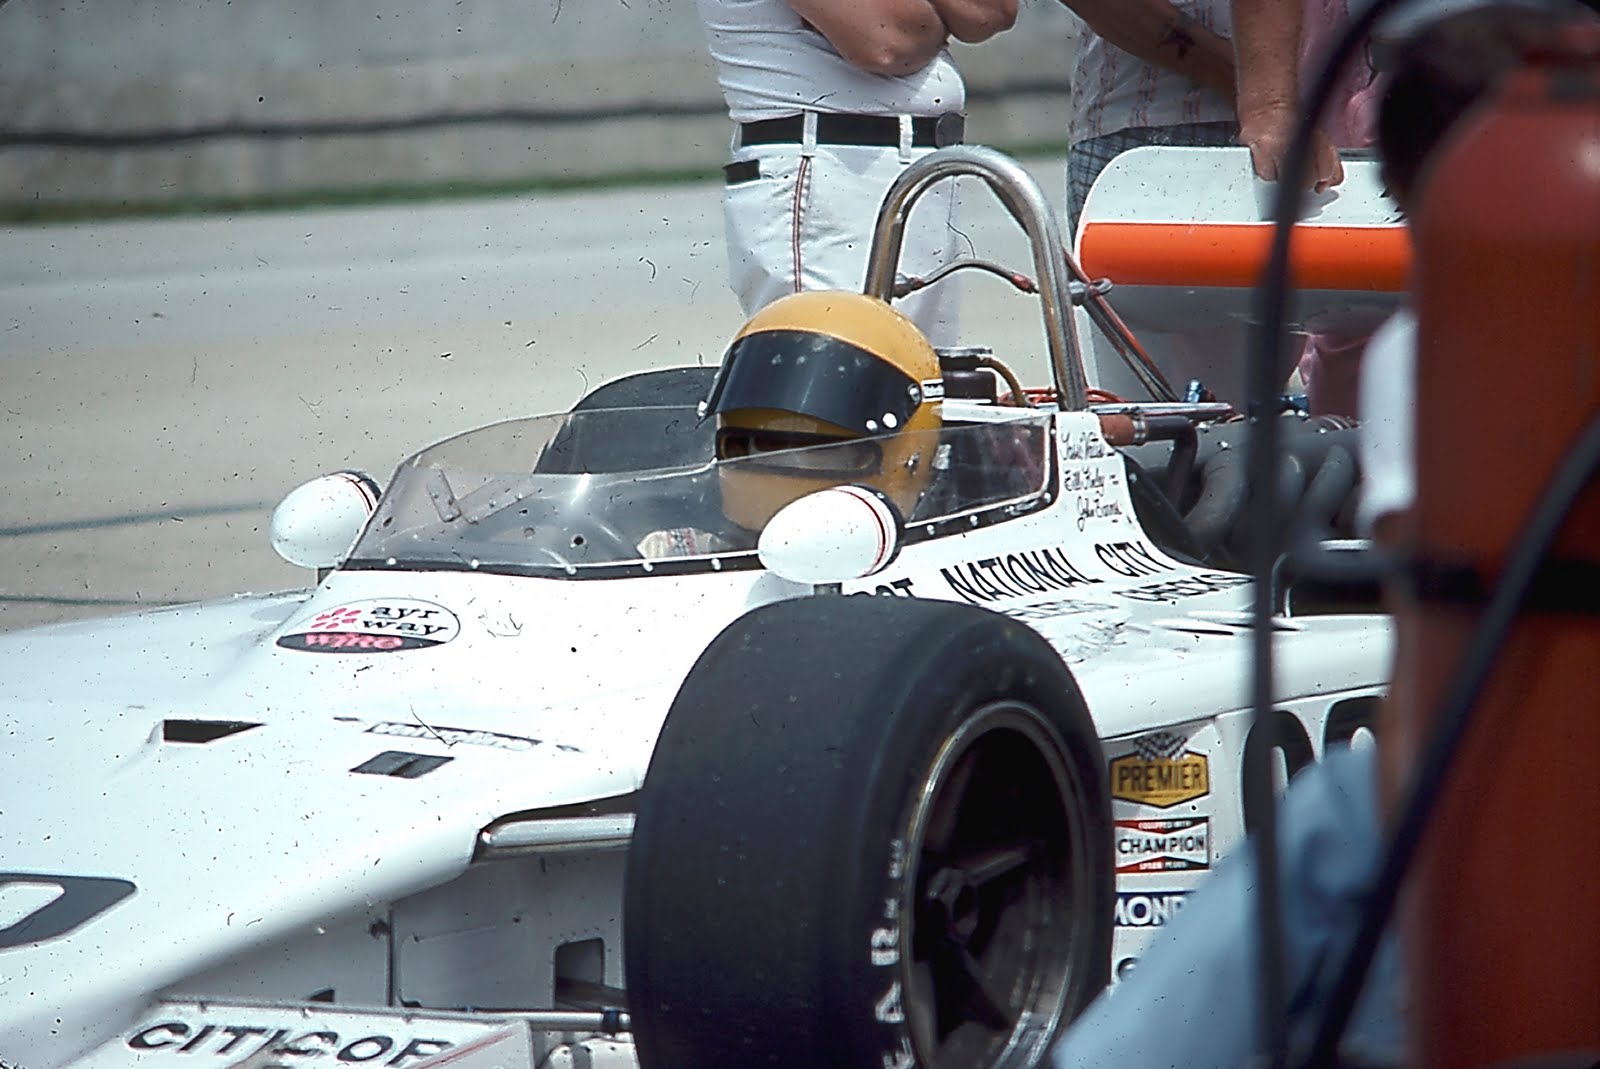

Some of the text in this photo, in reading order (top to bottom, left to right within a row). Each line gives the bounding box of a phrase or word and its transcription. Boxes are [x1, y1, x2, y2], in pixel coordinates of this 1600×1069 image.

[940, 547, 1105, 604] NATIONAL
[1094, 540, 1176, 578] CITY
[370, 606, 440, 620] ayr
[363, 619, 449, 636] way
[1117, 763, 1202, 792] PREMIER
[1117, 836, 1205, 855] CHAMPION
